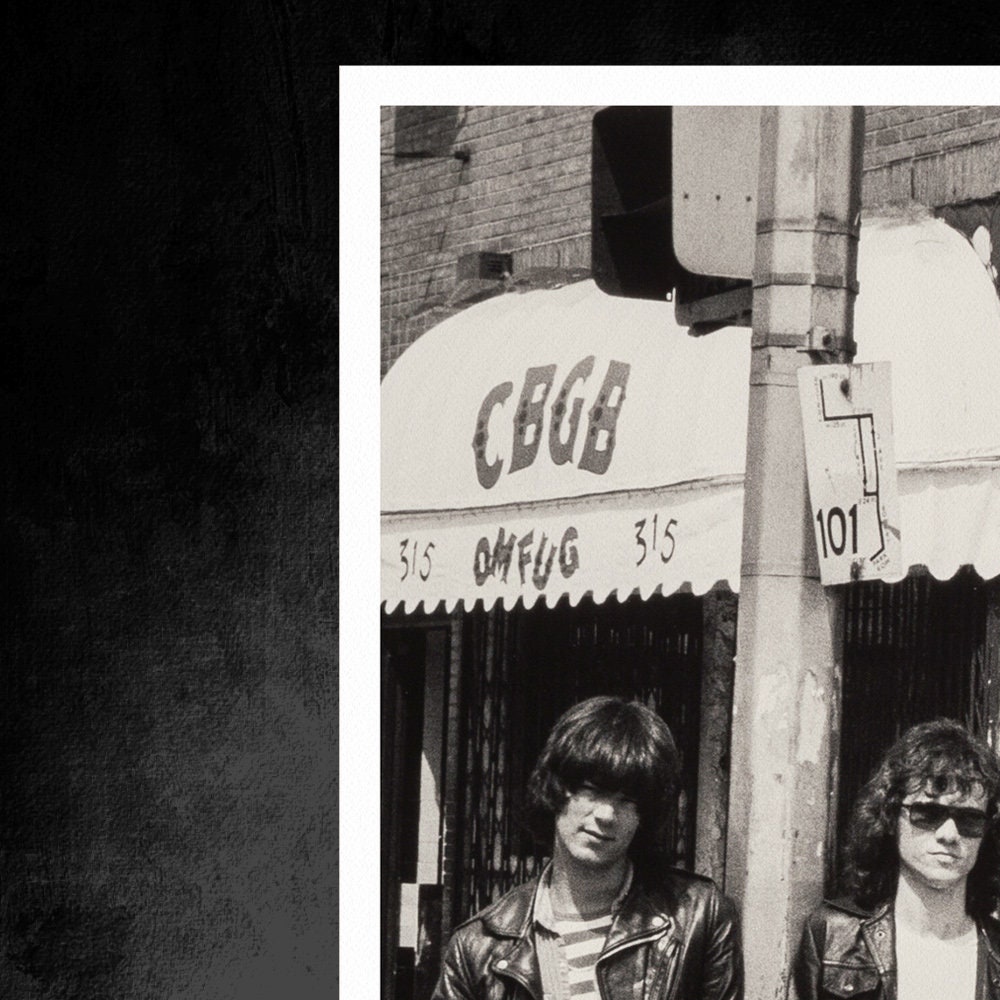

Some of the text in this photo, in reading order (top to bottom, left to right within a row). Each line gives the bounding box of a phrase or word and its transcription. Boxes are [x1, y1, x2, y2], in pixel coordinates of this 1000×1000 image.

[472, 355, 631, 489] CBGB
[400, 513, 677, 591] 315 OMFUG 315
[816, 503, 858, 558] 101
